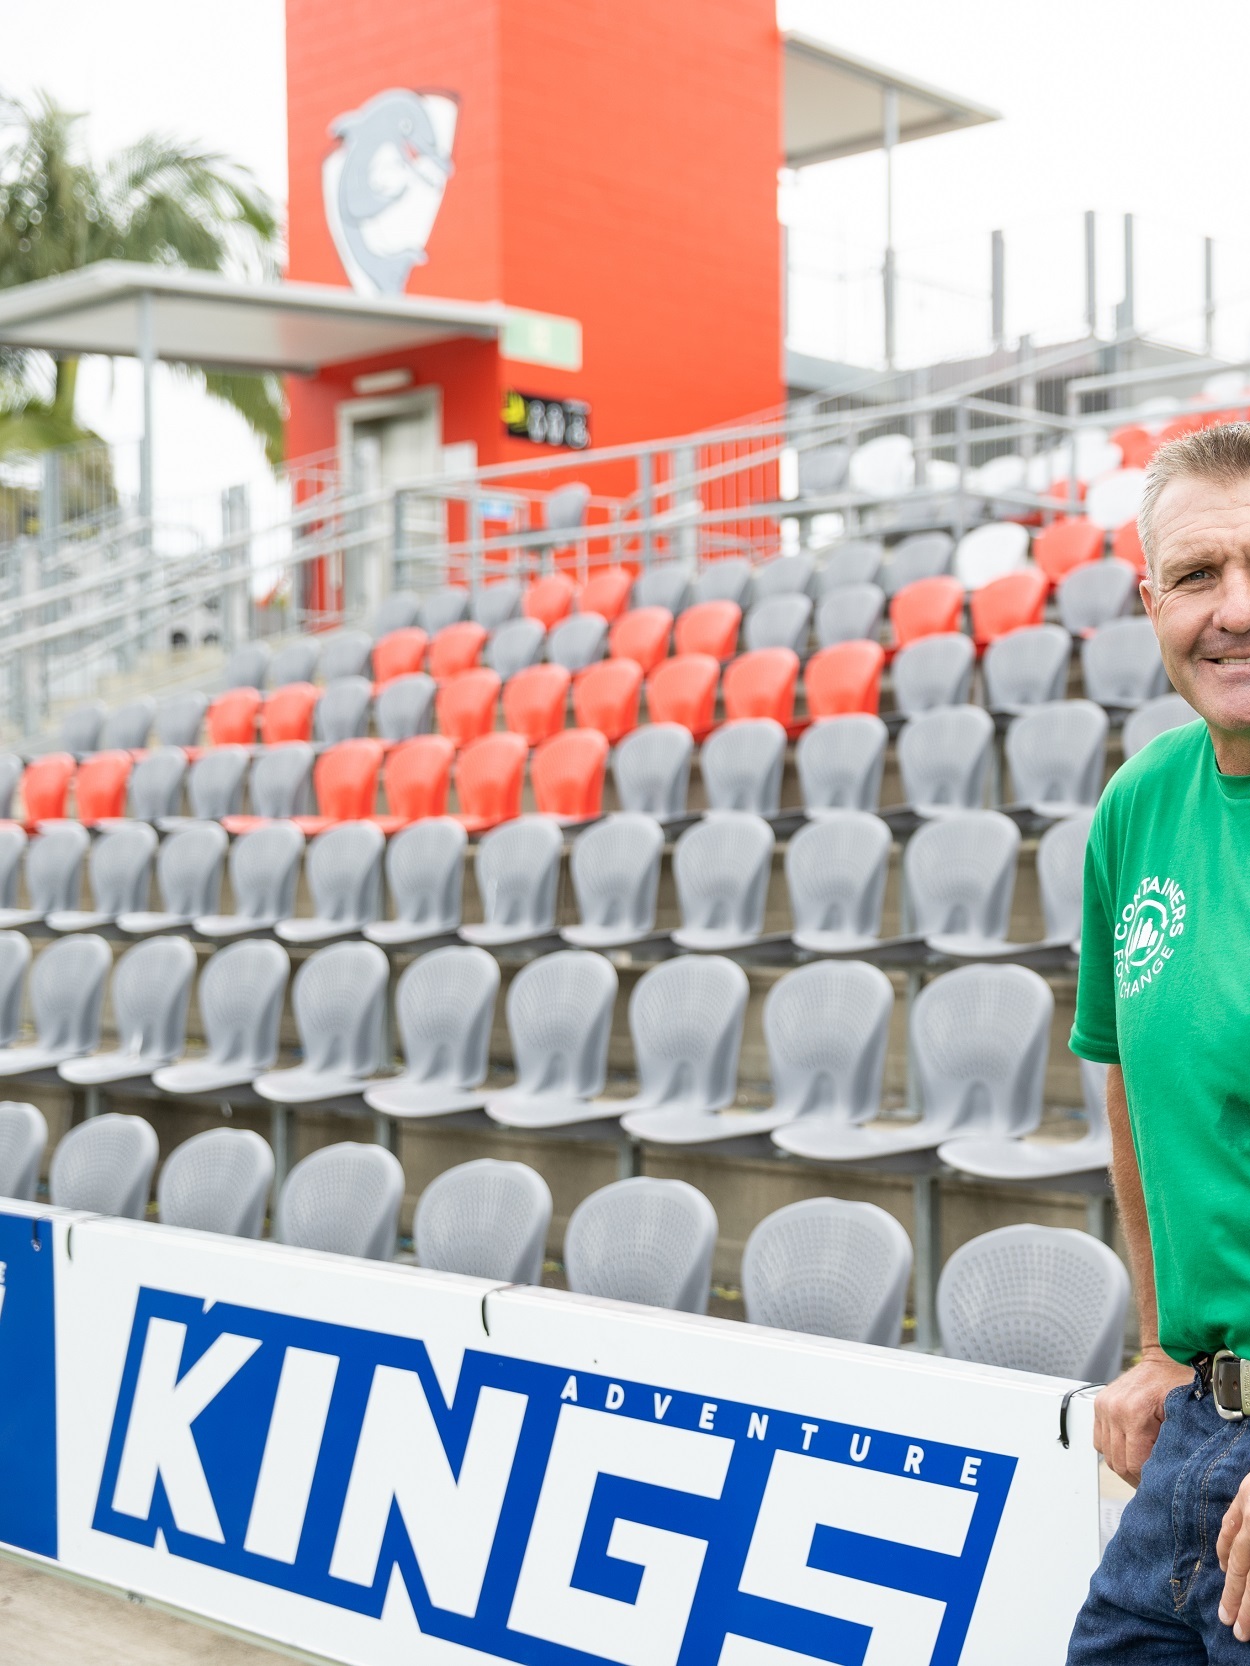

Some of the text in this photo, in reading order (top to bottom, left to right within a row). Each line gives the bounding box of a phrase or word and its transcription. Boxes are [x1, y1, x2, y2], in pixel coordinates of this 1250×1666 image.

[1115, 876, 1186, 940] CONTAINERS
[1120, 945, 1175, 999] CHANGE
[560, 1376, 982, 1487] ADVENTURE
[111, 1316, 979, 1666] KINGS
